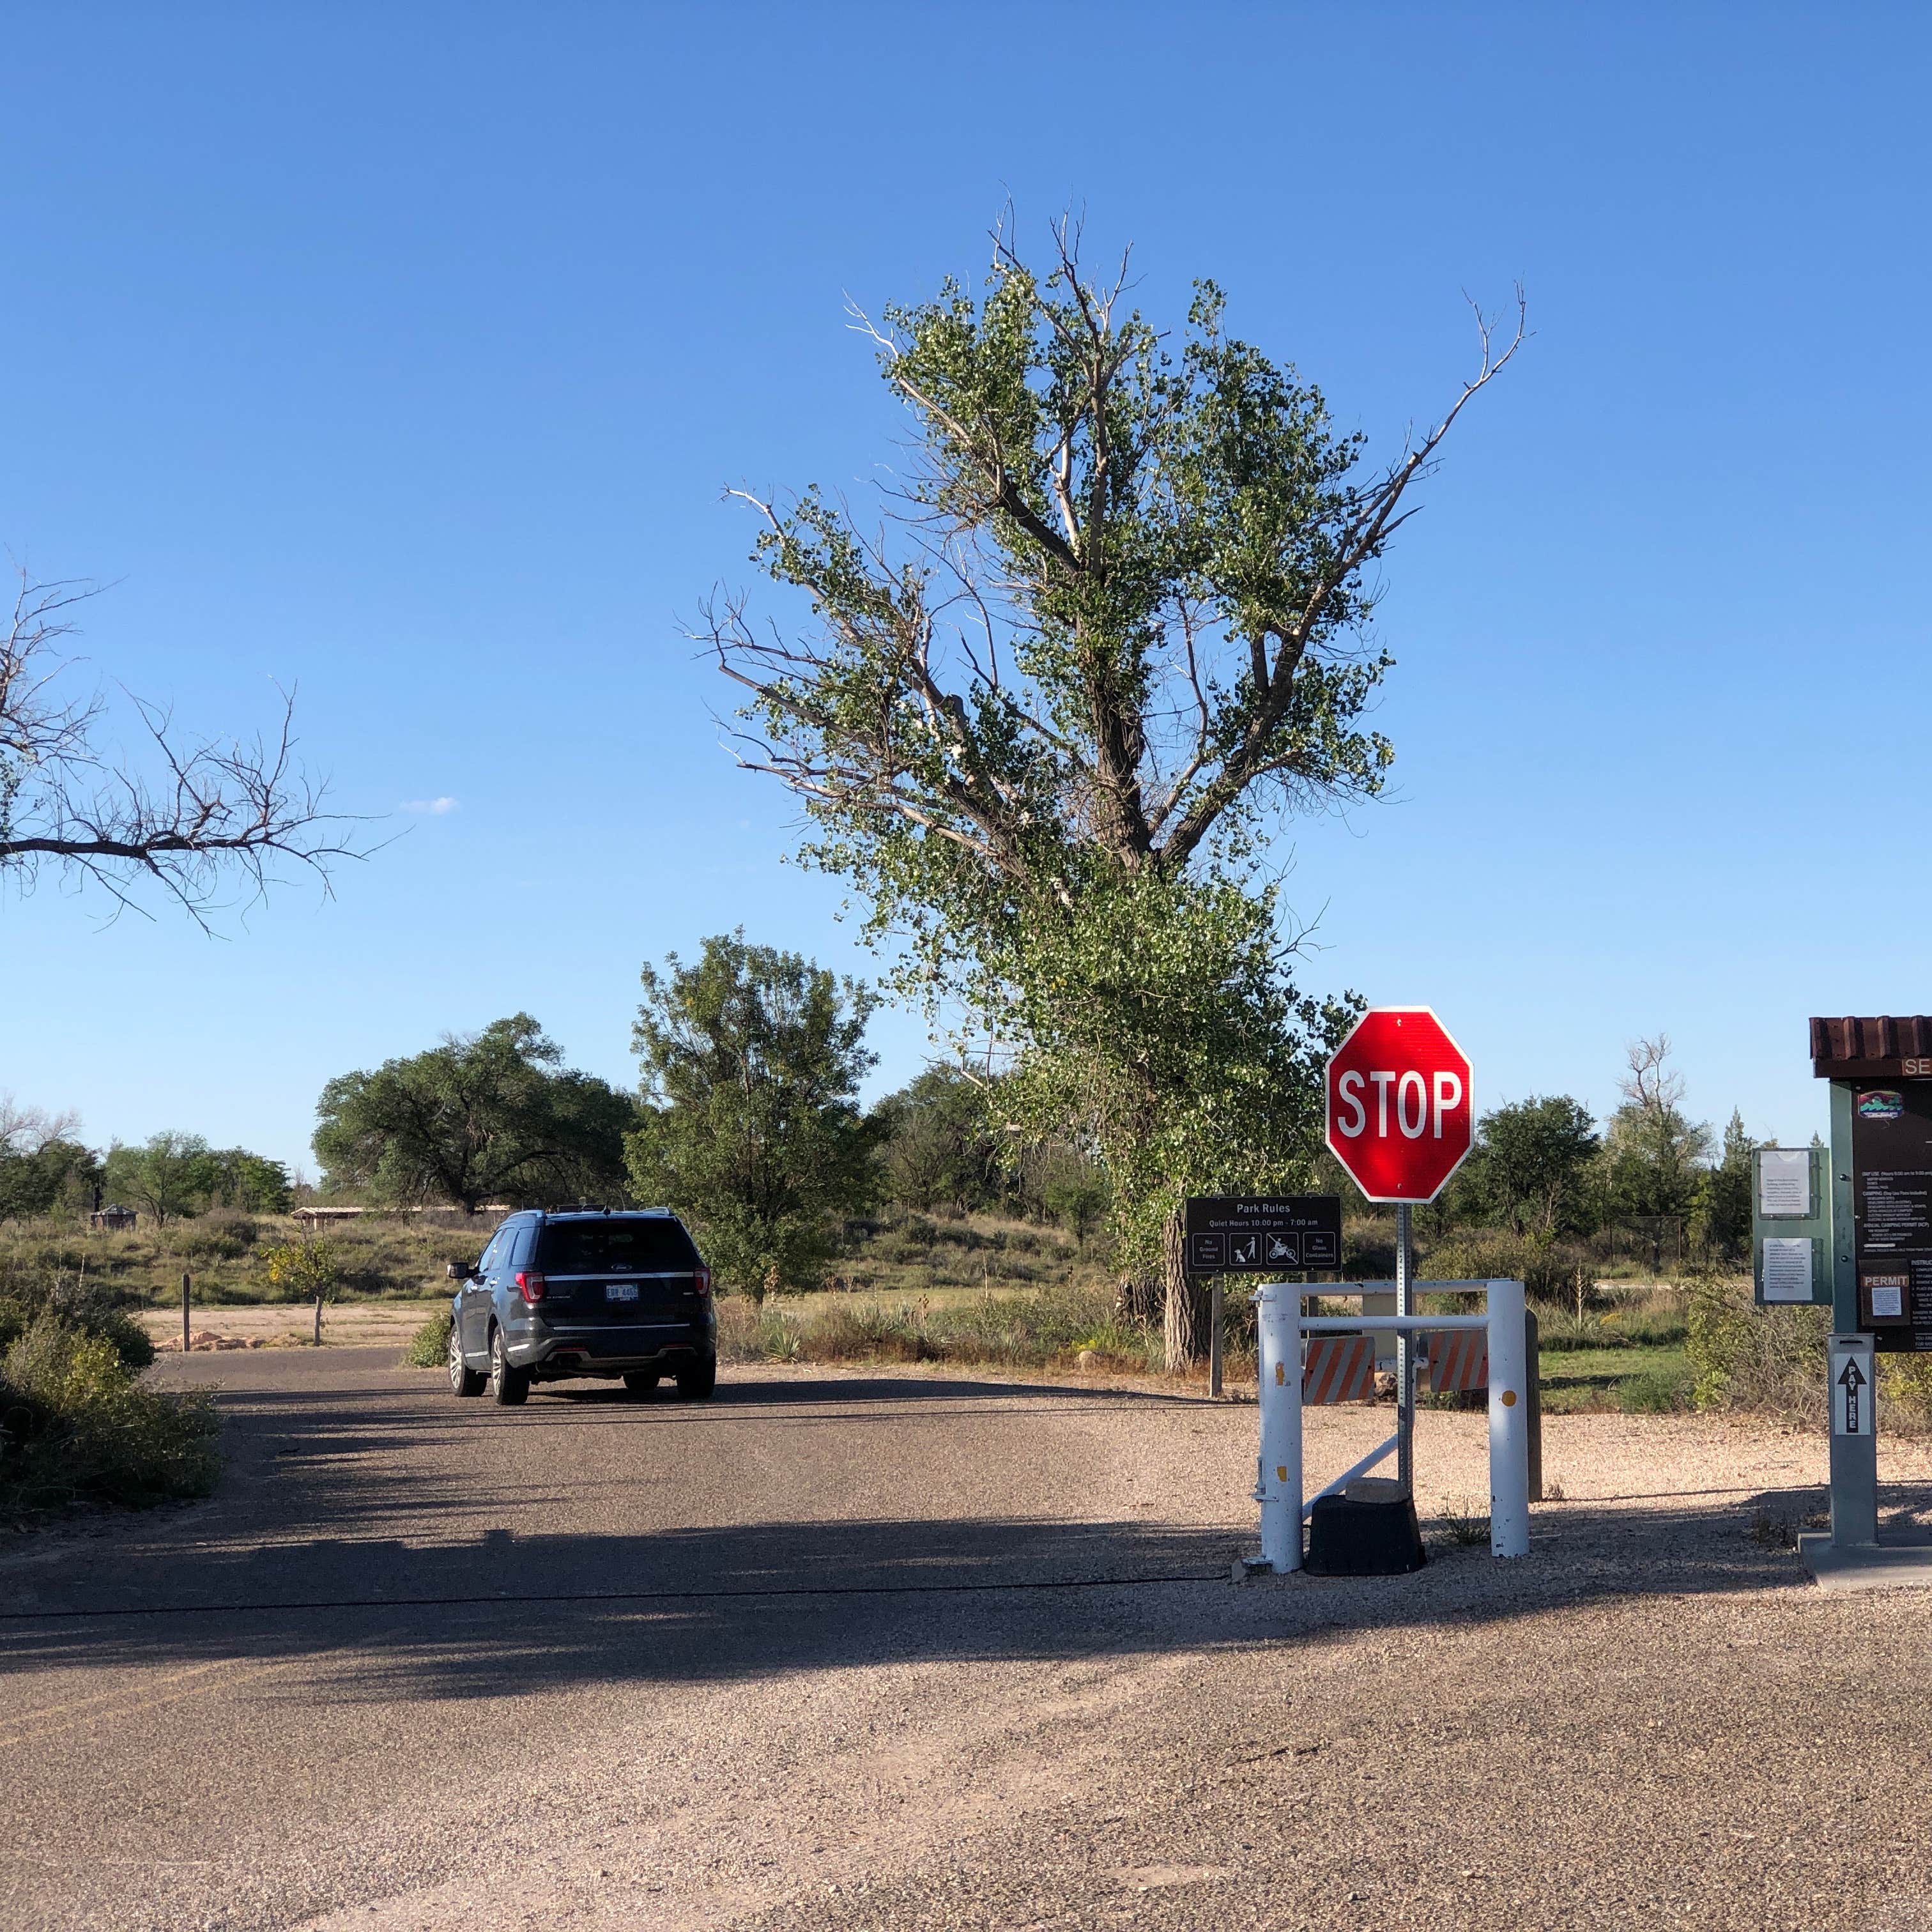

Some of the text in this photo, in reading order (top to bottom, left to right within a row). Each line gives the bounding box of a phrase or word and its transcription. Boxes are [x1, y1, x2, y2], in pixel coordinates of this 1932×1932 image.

[1337, 1070, 1462, 1139] STOP
[1237, 1204, 1291, 1213] Park Rules
[1209, 1220, 1228, 1228] Quiet
[1865, 1276, 1908, 1286] PERMIT
[1848, 1366, 1856, 1391] PAY
[1848, 1395, 1857, 1429] HERE
